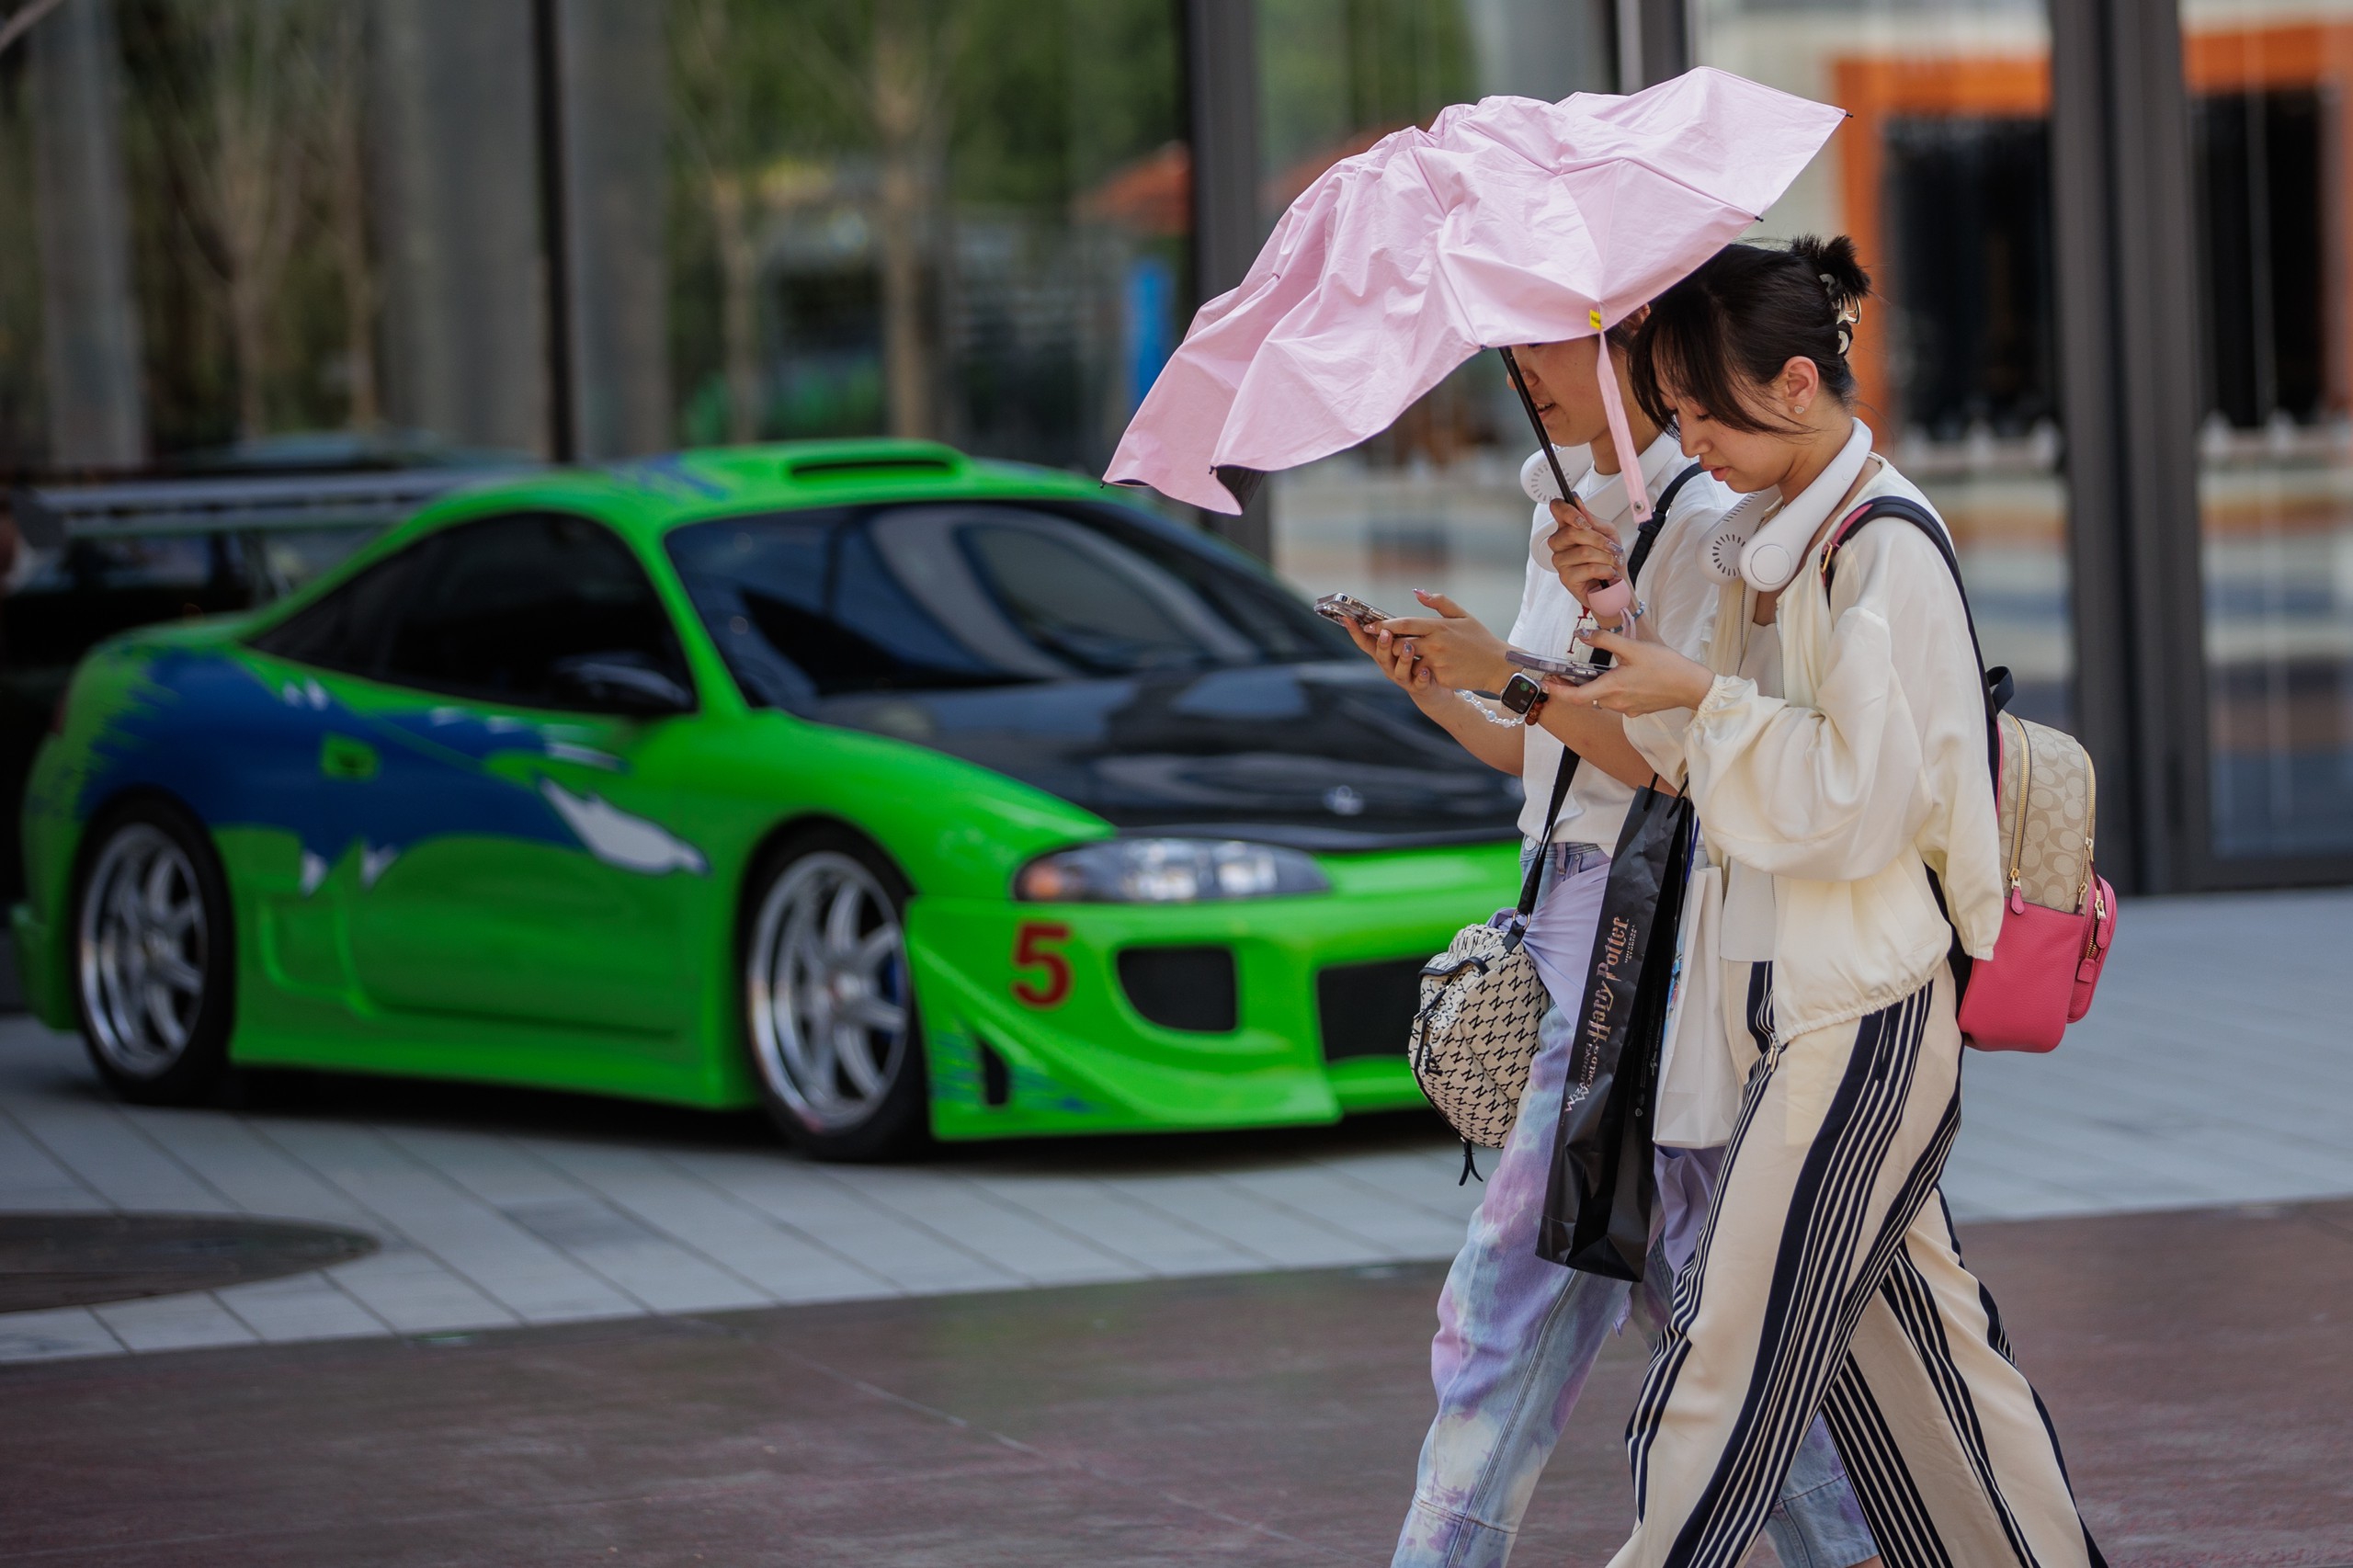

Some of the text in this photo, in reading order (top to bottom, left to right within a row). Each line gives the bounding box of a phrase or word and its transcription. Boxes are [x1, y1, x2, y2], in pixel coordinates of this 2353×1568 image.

[1011, 919, 1075, 1010] 5
[1586, 916, 1629, 1043] Harry Potter
[1574, 1056, 1598, 1102] WORLD
